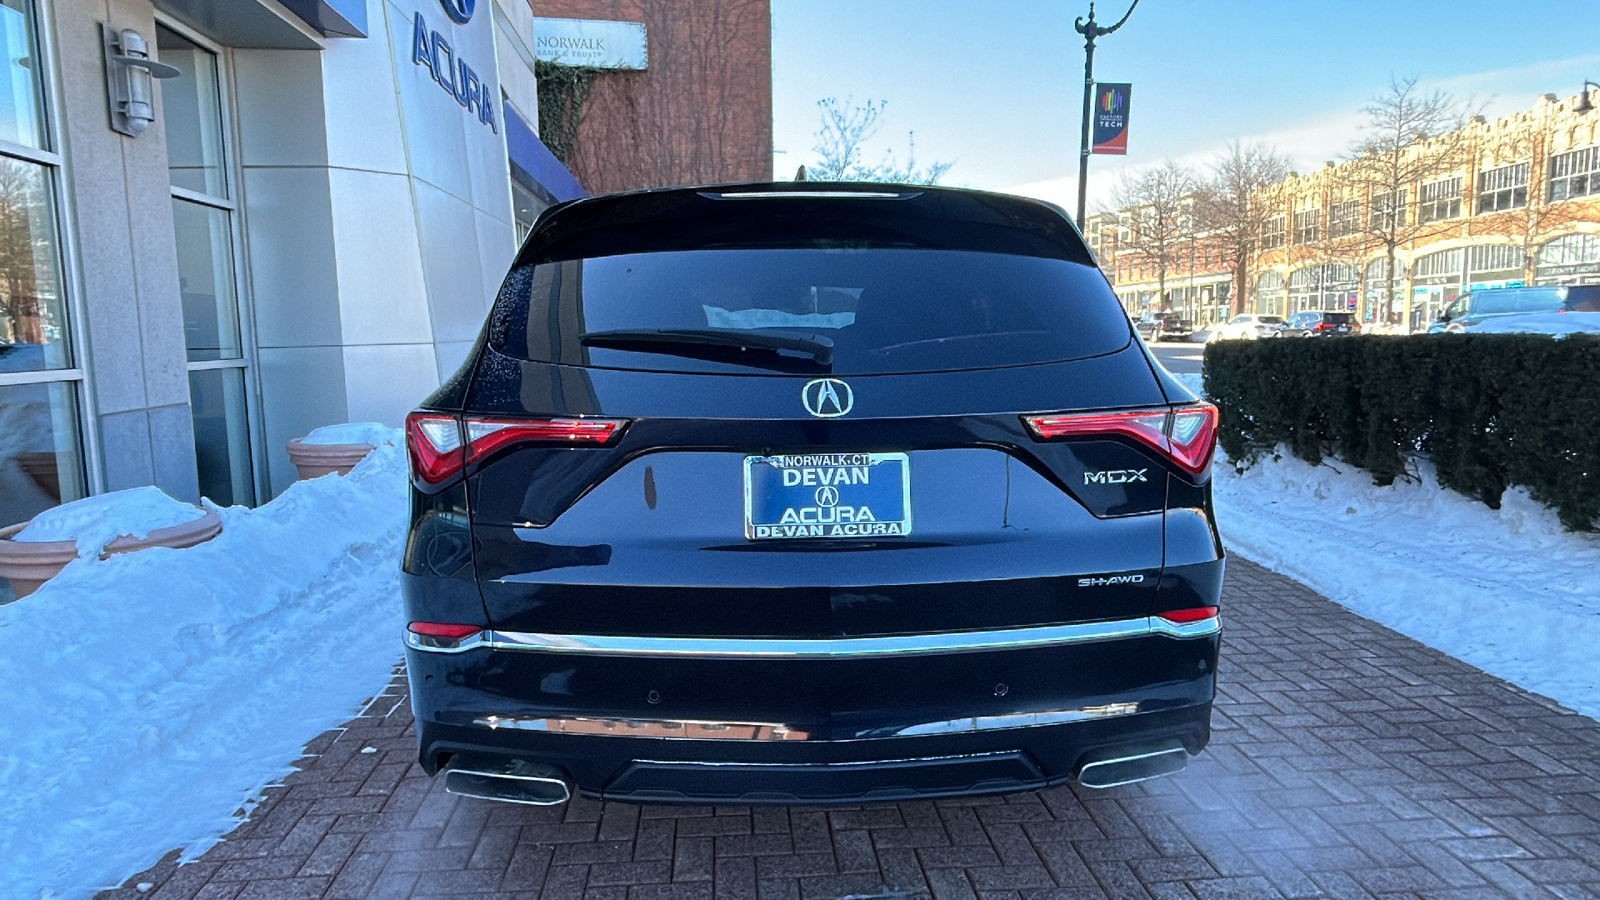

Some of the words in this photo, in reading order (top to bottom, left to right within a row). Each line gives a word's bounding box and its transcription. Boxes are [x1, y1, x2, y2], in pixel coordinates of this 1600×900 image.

[537, 36, 605, 50] NORWALK
[413, 11, 497, 135] ACURA
[852, 454, 869, 465] CT
[783, 467, 869, 486] DEVAN
[1083, 468, 1148, 485] MDX
[779, 506, 876, 524] ACURA
[757, 526, 824, 537] DEVAN
[831, 523, 901, 536] ACURA
[1077, 574, 1144, 587] SH-AWD
